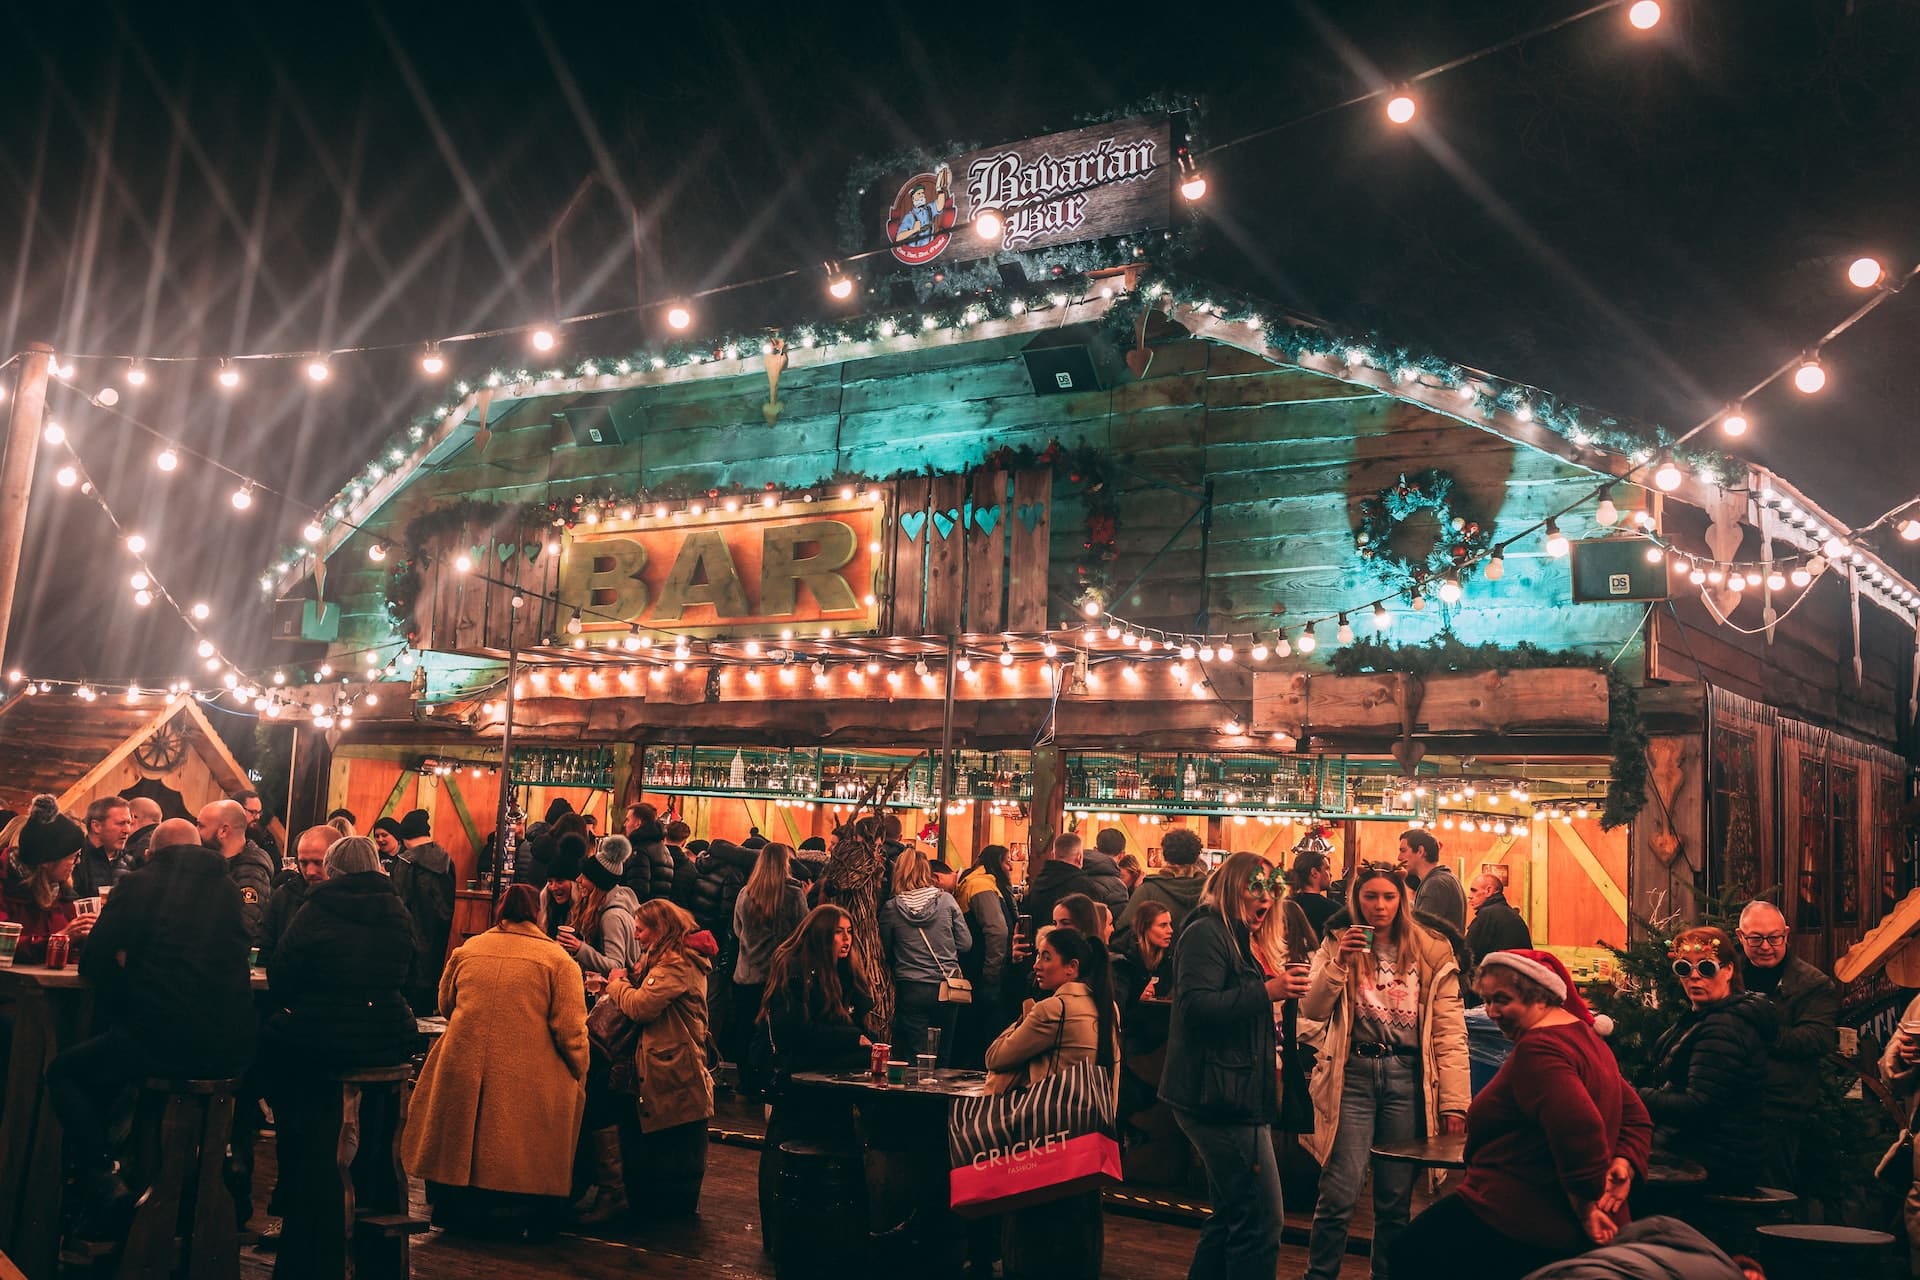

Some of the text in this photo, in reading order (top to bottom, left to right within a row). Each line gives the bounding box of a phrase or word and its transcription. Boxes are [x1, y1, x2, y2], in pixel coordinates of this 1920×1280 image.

[968, 138, 1157, 222] Bavarian
[1002, 192, 1089, 250] Bar
[559, 520, 861, 625] BAR
[1612, 577, 1627, 587] DS
[972, 1130, 1071, 1171] CRICKET
